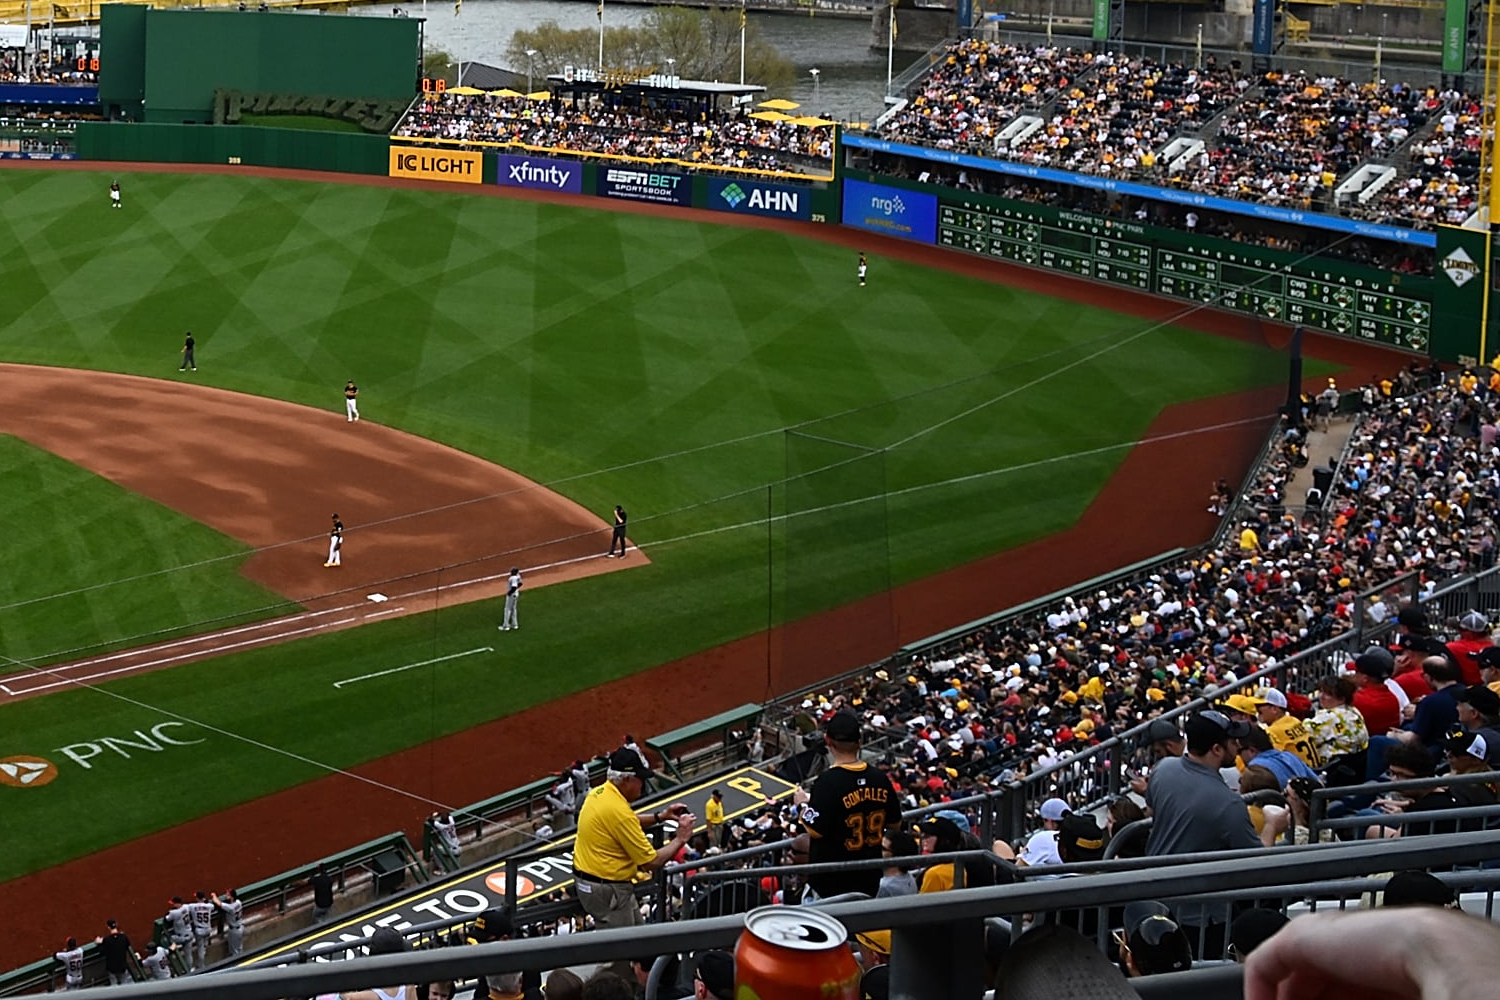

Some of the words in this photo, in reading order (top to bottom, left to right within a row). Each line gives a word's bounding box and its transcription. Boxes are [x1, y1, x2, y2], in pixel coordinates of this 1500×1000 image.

[422, 79, 446, 92] 0:18
[649, 74, 680, 89] TIME
[398, 154, 417, 171] IC
[421, 155, 475, 175] LIGHT
[508, 161, 570, 187] xfinity
[615, 183, 672, 196] SPORTSBOOK
[748, 188, 798, 213] AHN
[871, 197, 893, 215] nrg
[812, 214, 826, 223] 375
[1058, 211, 1093, 225] WELCOME
[1094, 218, 1104, 226] TO
[1112, 221, 1126, 231] PNC
[1127, 225, 1144, 234] PARK
[1162, 262, 1175, 271] LAA
[1161, 277, 1174, 285] CIN
[1290, 280, 1307, 289] CWS
[1290, 289, 1306, 298] BOS
[1362, 294, 1378, 303] NYY
[1292, 305, 1303, 313] KC
[1364, 304, 1375, 313] TB
[1290, 314, 1304, 322] DET
[1361, 320, 1377, 329] SEA
[1361, 329, 1376, 338] TOR
[51, 721, 206, 770] PNC
[727, 776, 767, 801] P
[842, 787, 889, 809] GONZALES
[844, 809, 887, 852] 39
[413, 889, 489, 920] TO
[519, 851, 577, 883] PN
